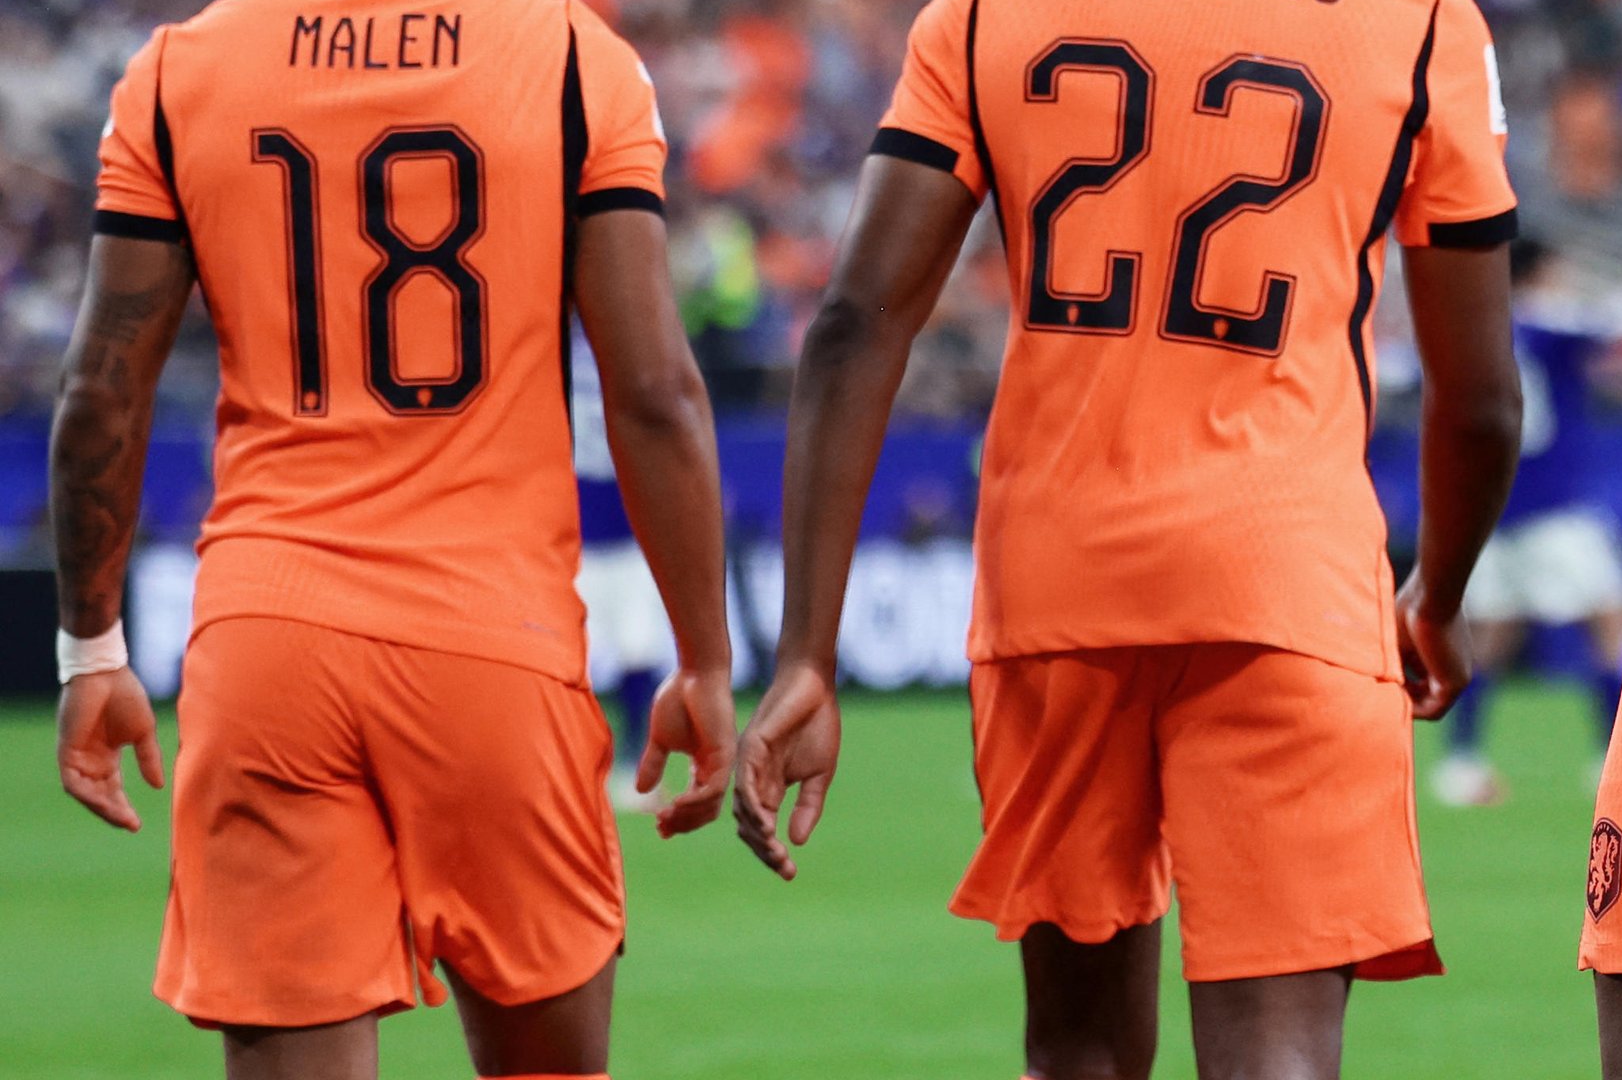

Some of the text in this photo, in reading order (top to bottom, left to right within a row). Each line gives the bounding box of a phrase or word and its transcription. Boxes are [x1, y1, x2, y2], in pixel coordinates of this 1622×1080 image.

[289, 14, 461, 70] MALEN
[251, 124, 489, 417] 18
[1024, 36, 1331, 358] 22
